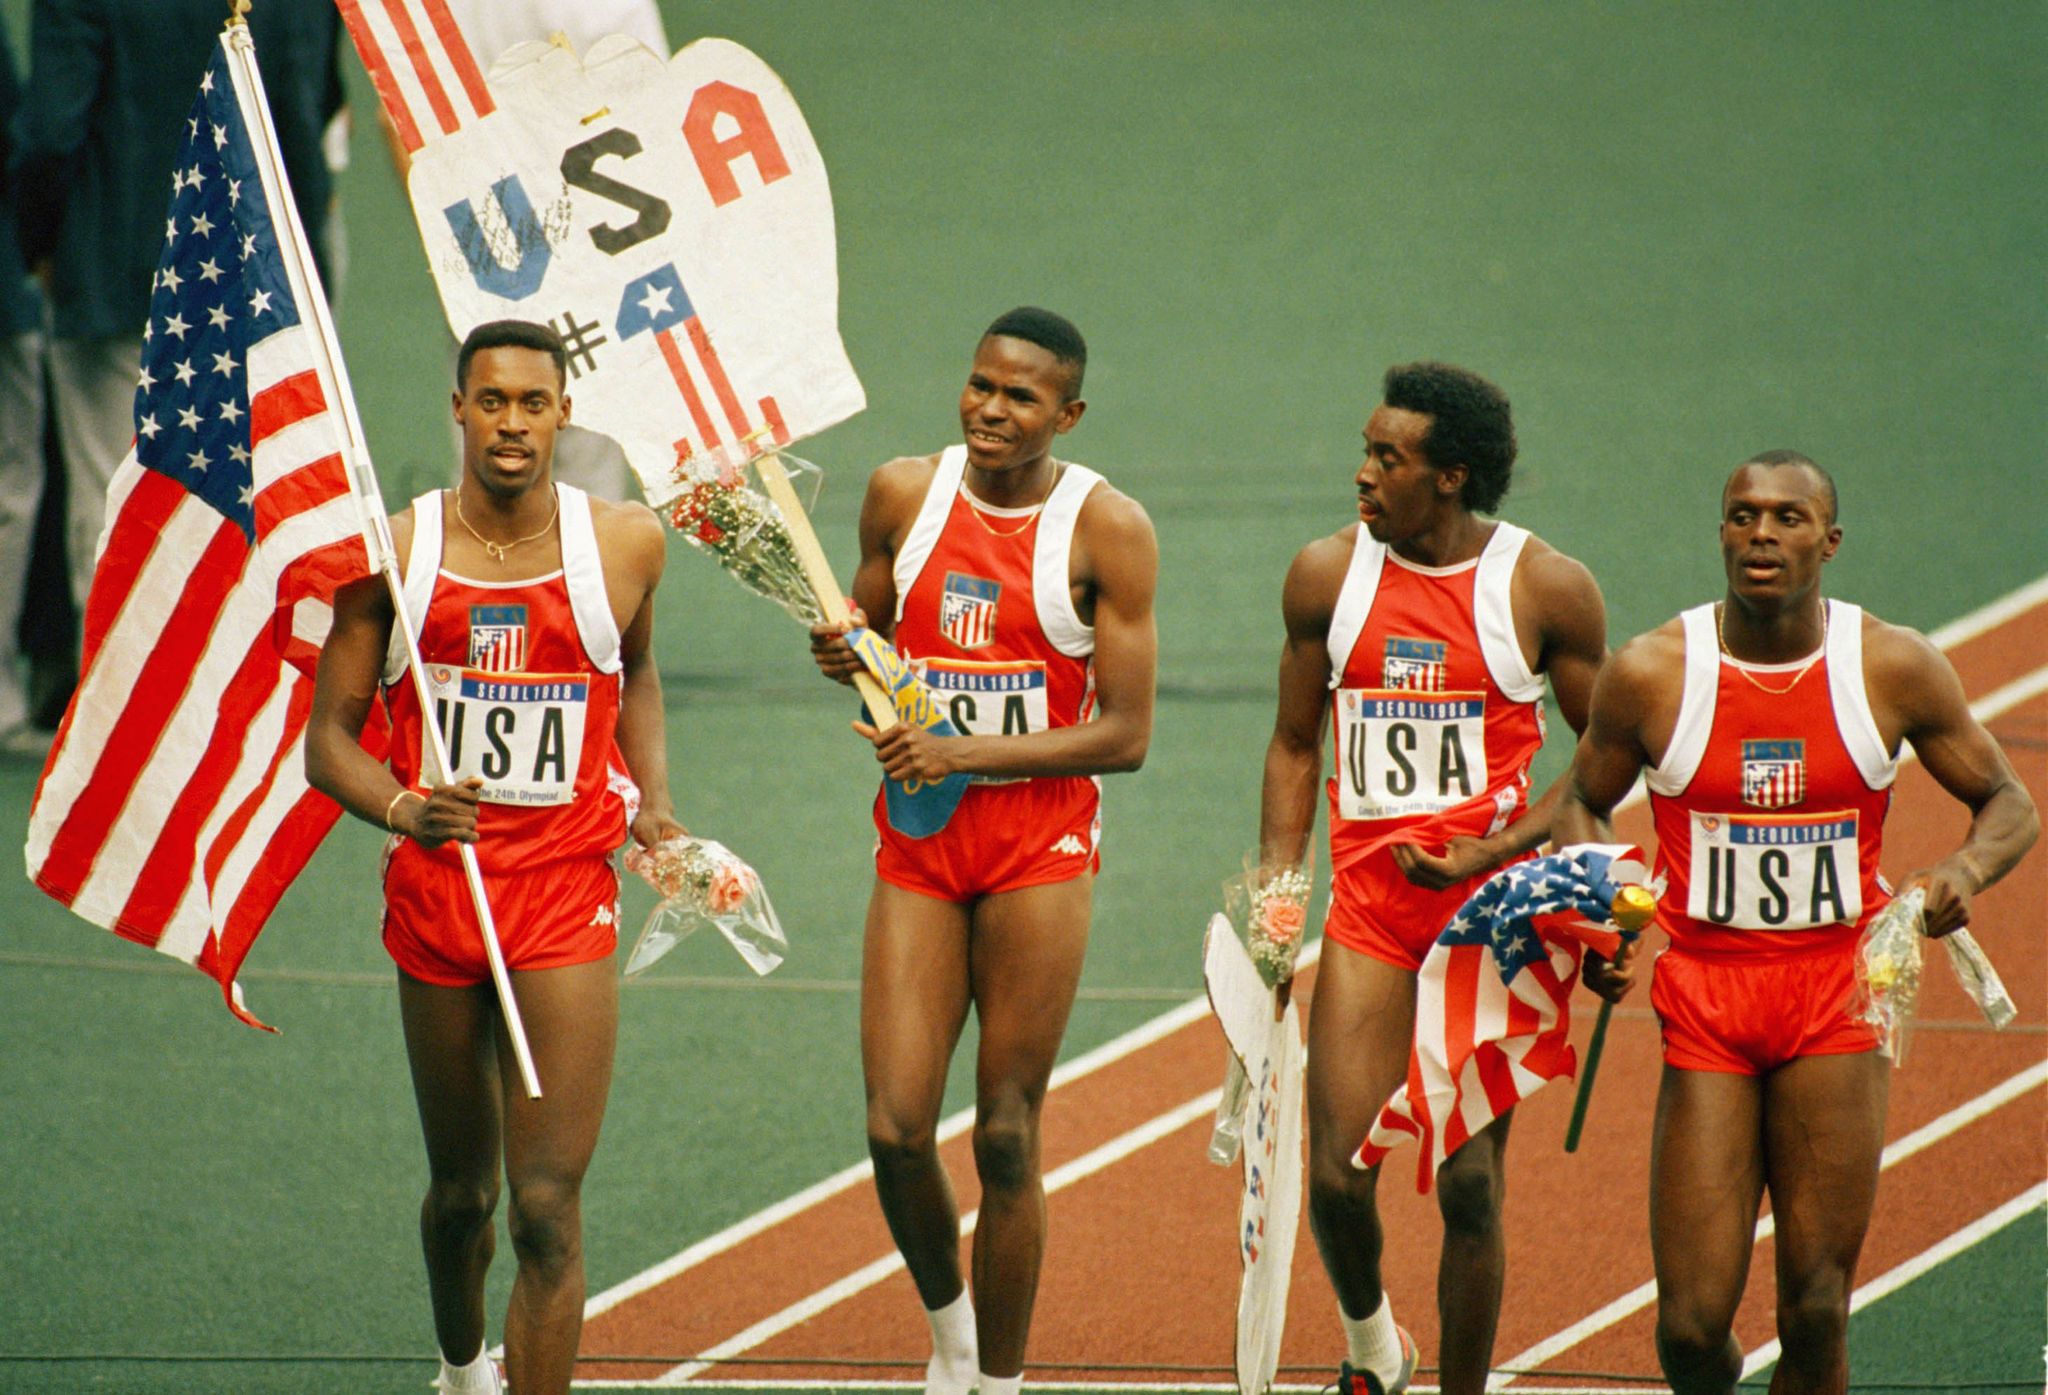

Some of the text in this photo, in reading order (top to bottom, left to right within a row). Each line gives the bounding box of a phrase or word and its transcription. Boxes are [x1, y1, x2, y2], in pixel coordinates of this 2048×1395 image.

[443, 80, 791, 301] USA
[495, 788, 517, 799] 24th
[519, 790, 559, 802] Olympiad
[1349, 721, 1472, 797] USA
[1706, 844, 1847, 925] USA
